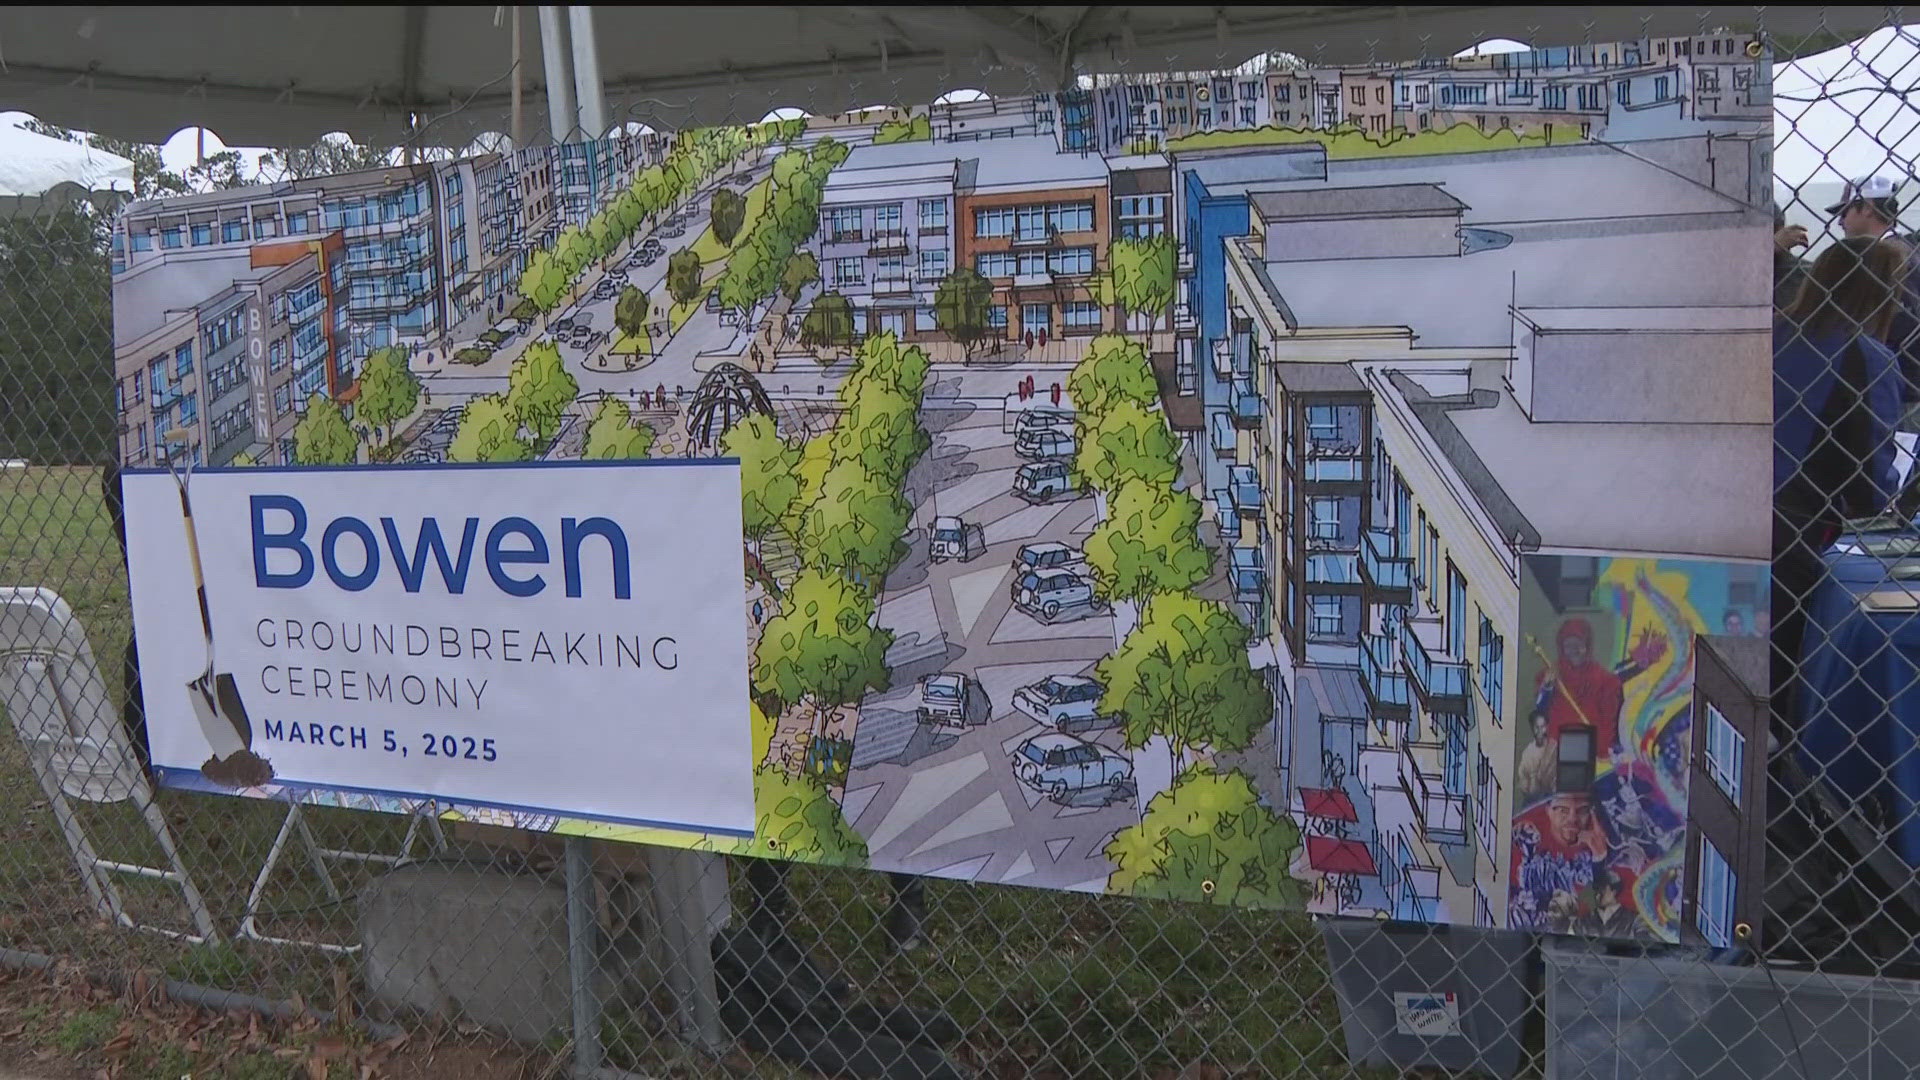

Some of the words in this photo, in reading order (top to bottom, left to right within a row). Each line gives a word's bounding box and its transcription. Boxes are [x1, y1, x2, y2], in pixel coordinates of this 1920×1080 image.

[250, 309, 269, 438] BOWEN
[249, 494, 631, 600] Bowen
[257, 618, 678, 670] GROUNDBREAKING
[261, 666, 488, 710] CEREMONY
[264, 719, 367, 750] MARCH
[383, 730, 408, 757] 5,
[423, 733, 498, 762] 2025
